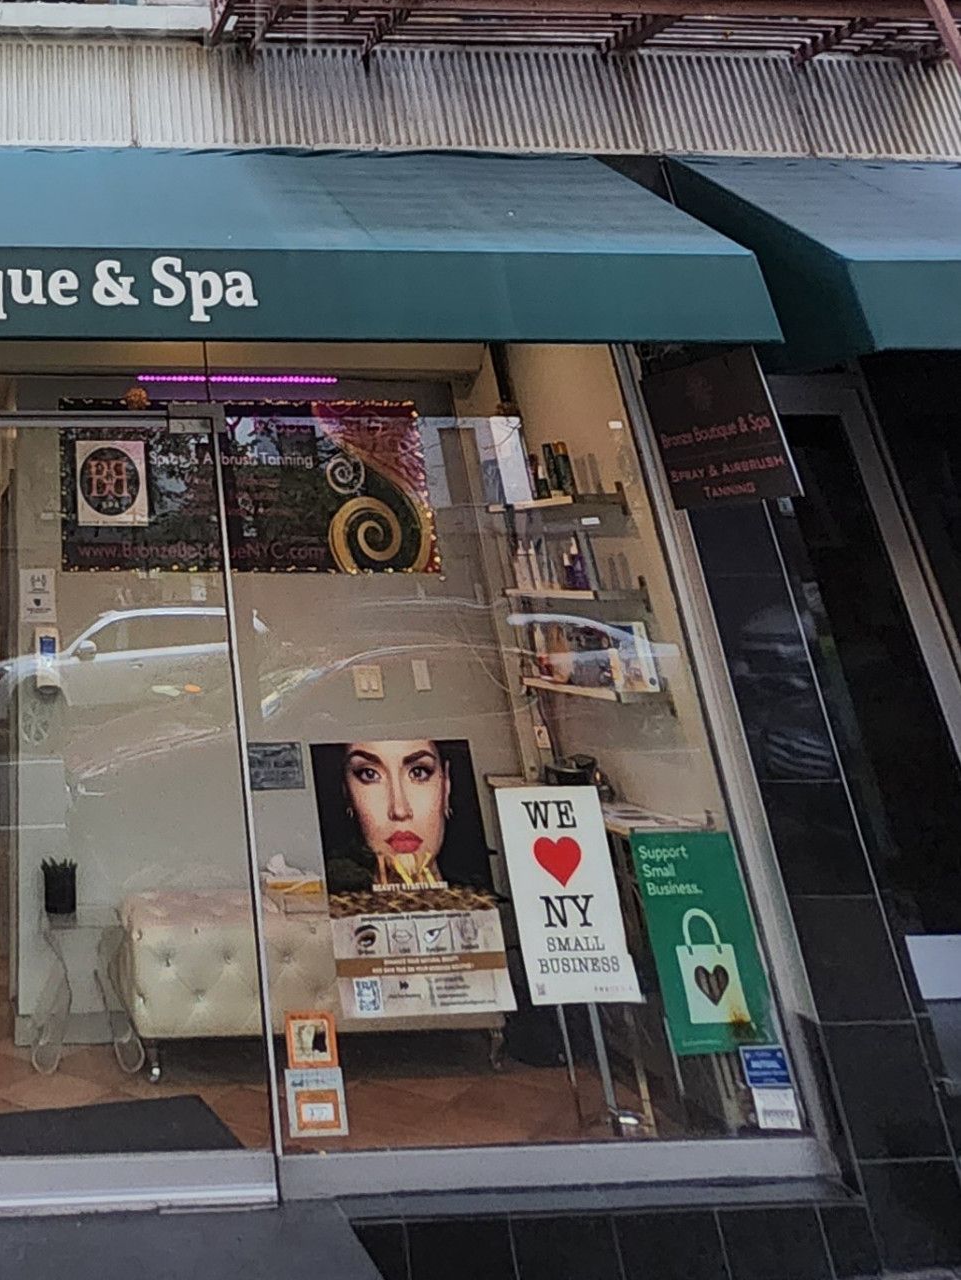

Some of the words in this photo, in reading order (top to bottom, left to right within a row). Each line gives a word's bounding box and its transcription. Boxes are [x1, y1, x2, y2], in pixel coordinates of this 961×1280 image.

[91, 260, 139, 306] &
[151, 255, 259, 322] Spa
[749, 413, 771, 433] Spa
[521, 799, 577, 829] WE
[638, 845, 688, 860] Support
[642, 863, 676, 878] Small
[646, 881, 703, 896] Business.
[539, 894, 594, 928] NY
[546, 935, 606, 952] SMALL
[538, 956, 620, 975] BUSINESS
